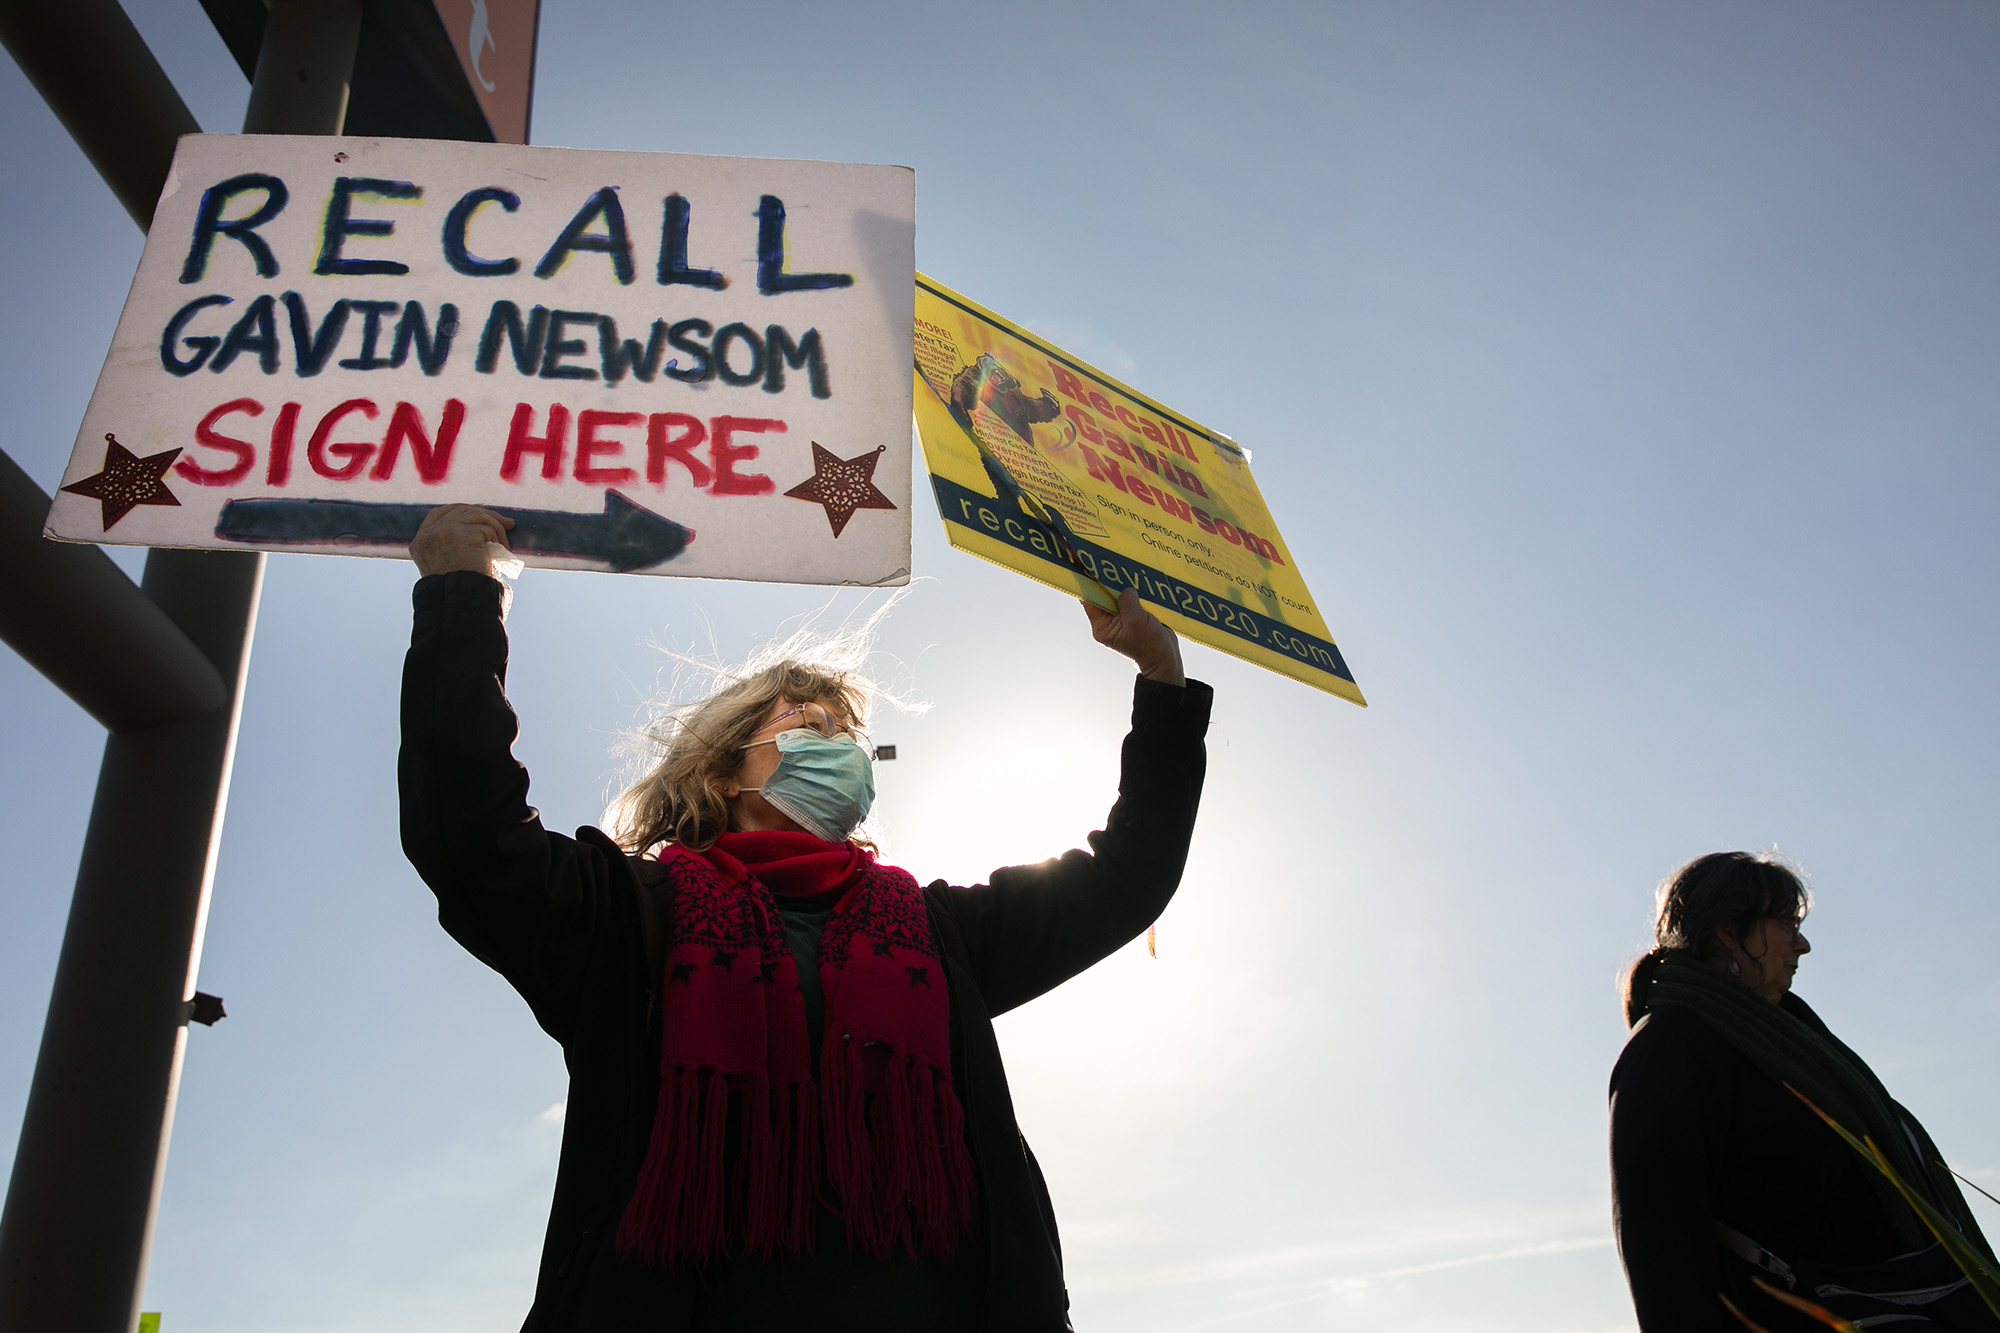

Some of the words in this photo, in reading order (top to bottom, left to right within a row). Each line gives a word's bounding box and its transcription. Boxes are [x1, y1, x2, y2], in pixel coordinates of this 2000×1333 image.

[178, 172, 857, 295] RECALL
[160, 291, 459, 378] GAVIN
[475, 300, 832, 399] NEWSOM
[914, 318, 953, 341] MORE!
[914, 332, 934, 345] ater
[936, 339, 957, 354] Tax
[914, 340, 929, 351] REE
[992, 426, 1022, 442] Control
[1047, 360, 1199, 464] Recall
[173, 397, 466, 487] SIGN
[499, 402, 789, 497] HERE
[975, 428, 1008, 446] Highest
[1008, 440, 1023, 450] Gas
[1023, 445, 1038, 456] Tax
[991, 450, 1064, 483] Overreach
[1065, 404, 1209, 500] Gavin
[1006, 464, 1028, 479] High
[1028, 473, 1065, 492] Income
[1064, 485, 1083, 499] Tax
[1078, 442, 1285, 566] Newsom
[1097, 494, 1126, 516] Sign
[1128, 509, 1141, 523] in
[1143, 518, 1185, 543] person
[1141, 533, 1181, 558] Online
[1184, 554, 1233, 582] petitions
[1235, 575, 1250, 589] do
[1252, 581, 1279, 600] NOT
[1281, 596, 1312, 615] count
